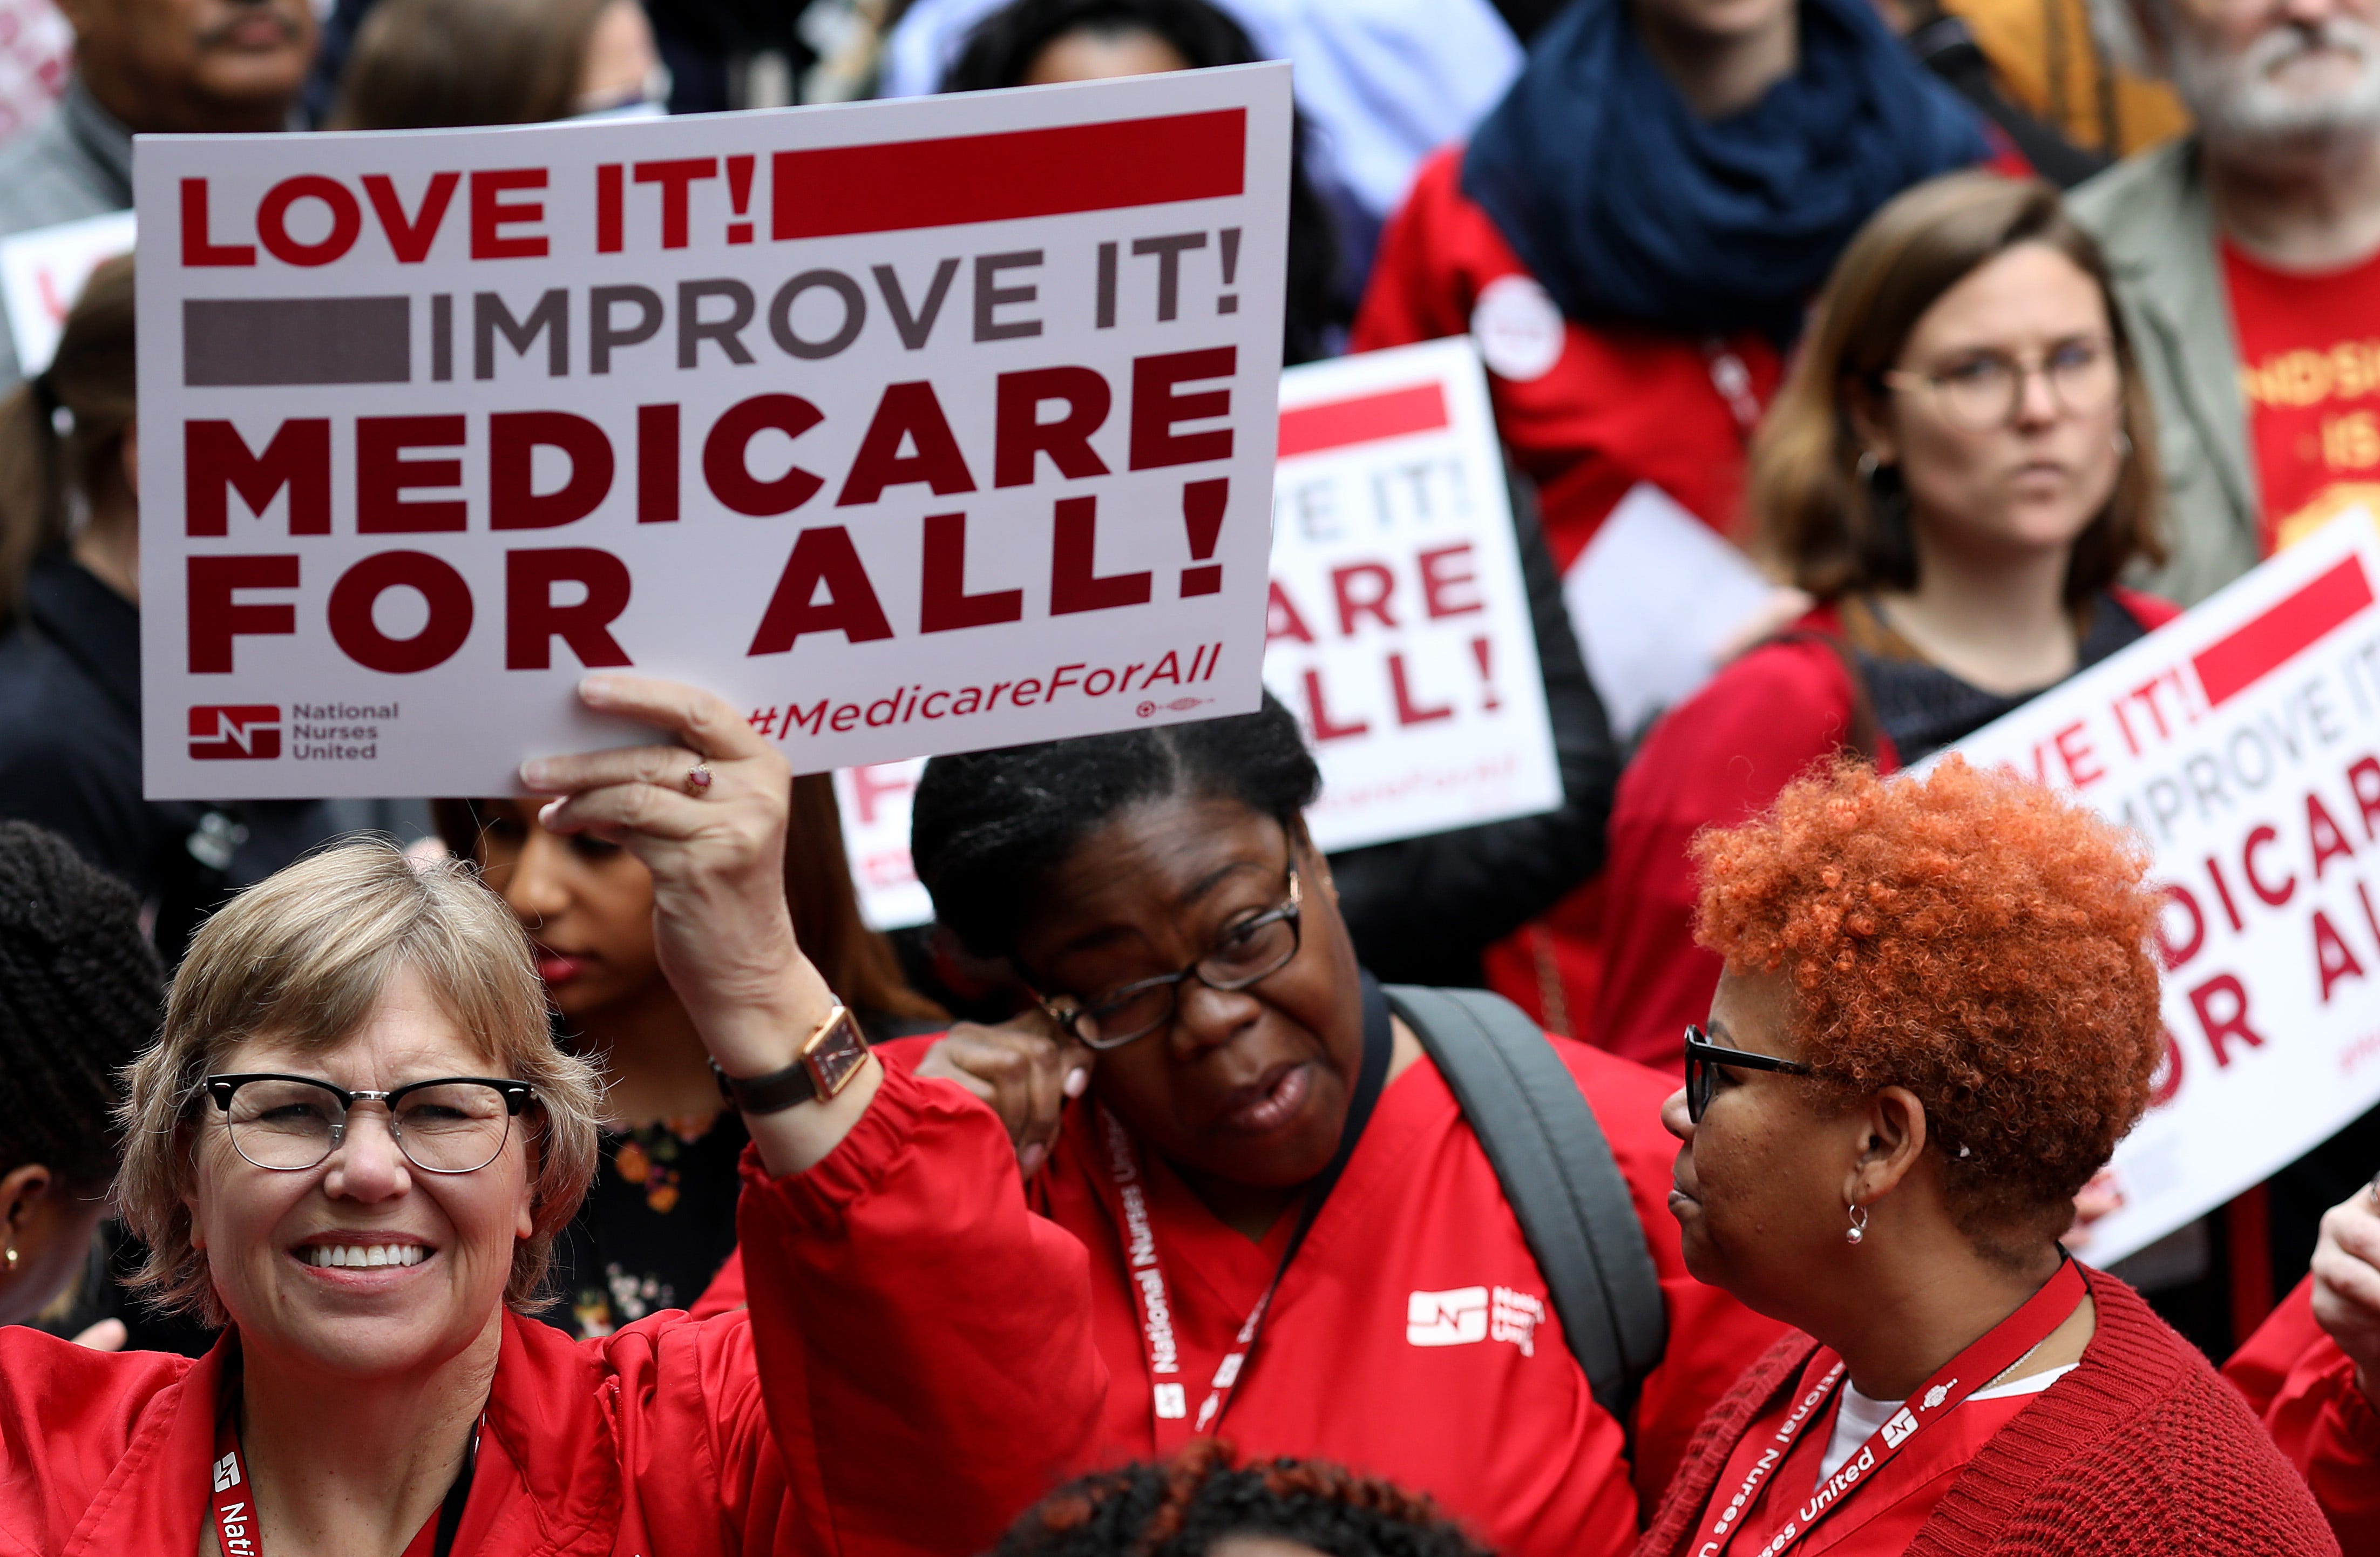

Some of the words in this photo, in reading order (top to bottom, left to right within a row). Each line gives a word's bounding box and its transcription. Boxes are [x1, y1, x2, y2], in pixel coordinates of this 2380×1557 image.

[180, 166, 550, 267] LOVE
[595, 153, 755, 254] IT!
[431, 248, 1045, 382] IMPROVE
[1095, 226, 1242, 330] IT!
[184, 344, 1237, 537] MEDICARE
[186, 546, 635, 674] FOR
[745, 477, 1230, 657] ALL!
[292, 702, 399, 720] National
[292, 723, 378, 741] Nurses
[747, 642, 1223, 740] #MedicareForAll
[1303, 634, 1502, 744] LL!
[292, 742, 378, 761] United
[1134, 1268, 1179, 1374] National
[1774, 1359, 1844, 1444] ational
[220, 1502, 255, 1557] Nati
[1713, 1447, 1780, 1535] Nurses
[1757, 1521, 1797, 1557] ses
[1799, 1445, 1876, 1522] United
